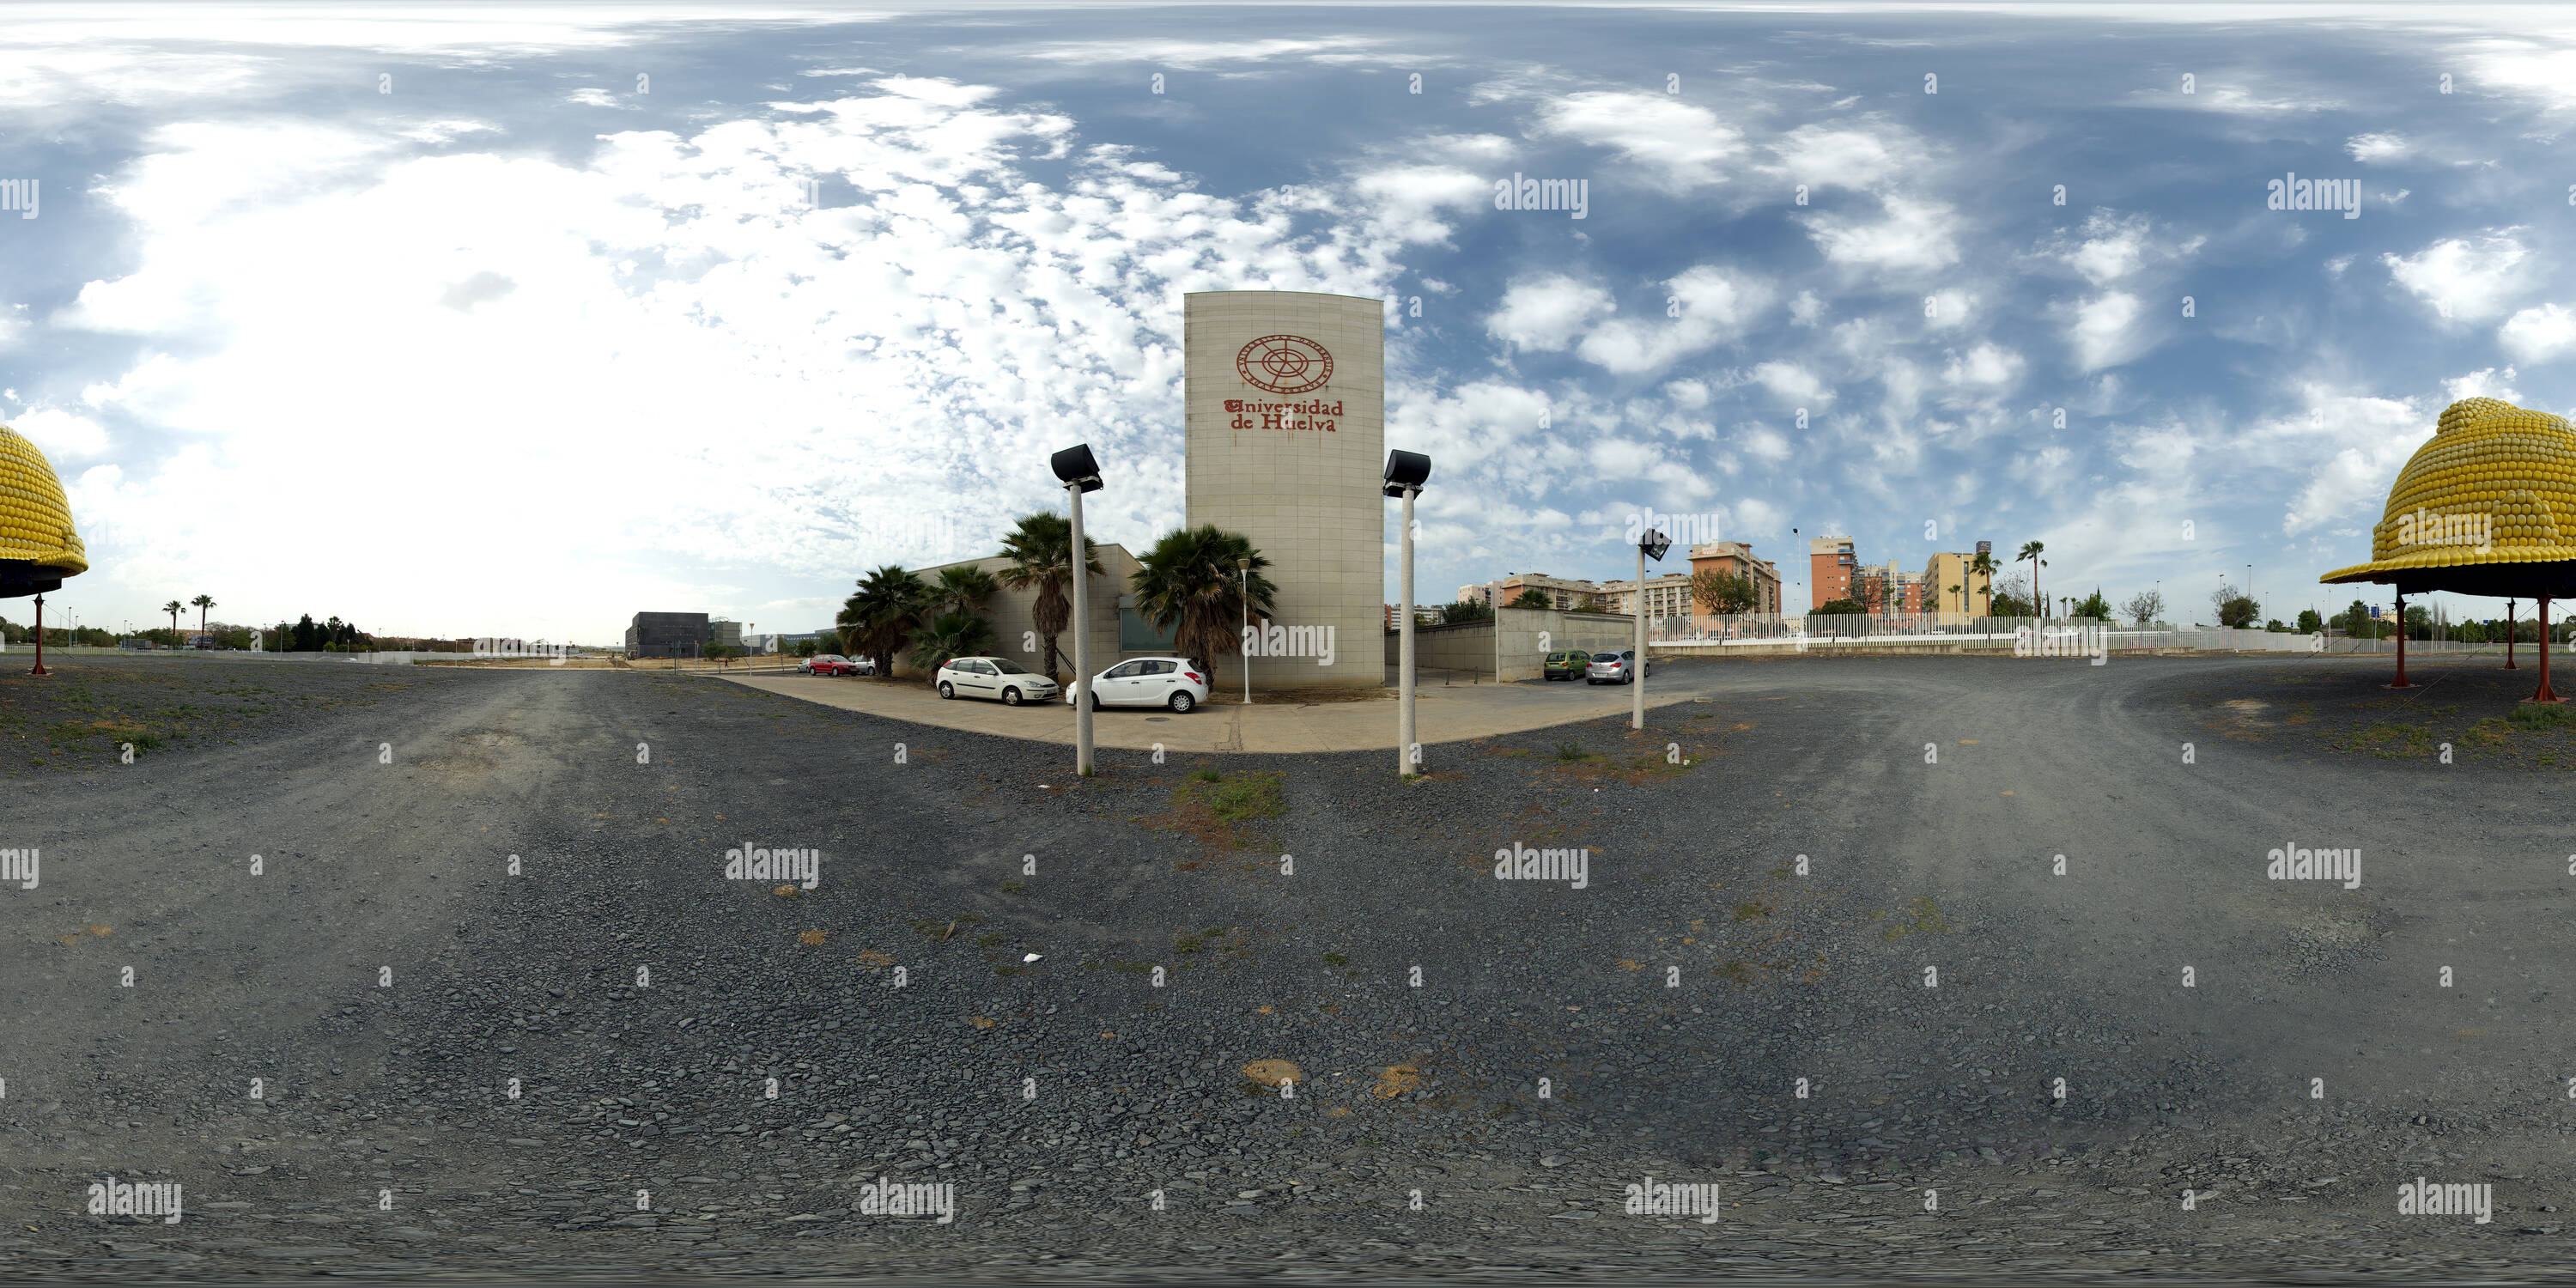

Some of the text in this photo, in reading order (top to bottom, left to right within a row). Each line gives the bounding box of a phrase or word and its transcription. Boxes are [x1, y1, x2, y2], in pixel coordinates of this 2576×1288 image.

[1224, 398, 1343, 416] Universidad
[1231, 414, 1335, 431] de Huelva
